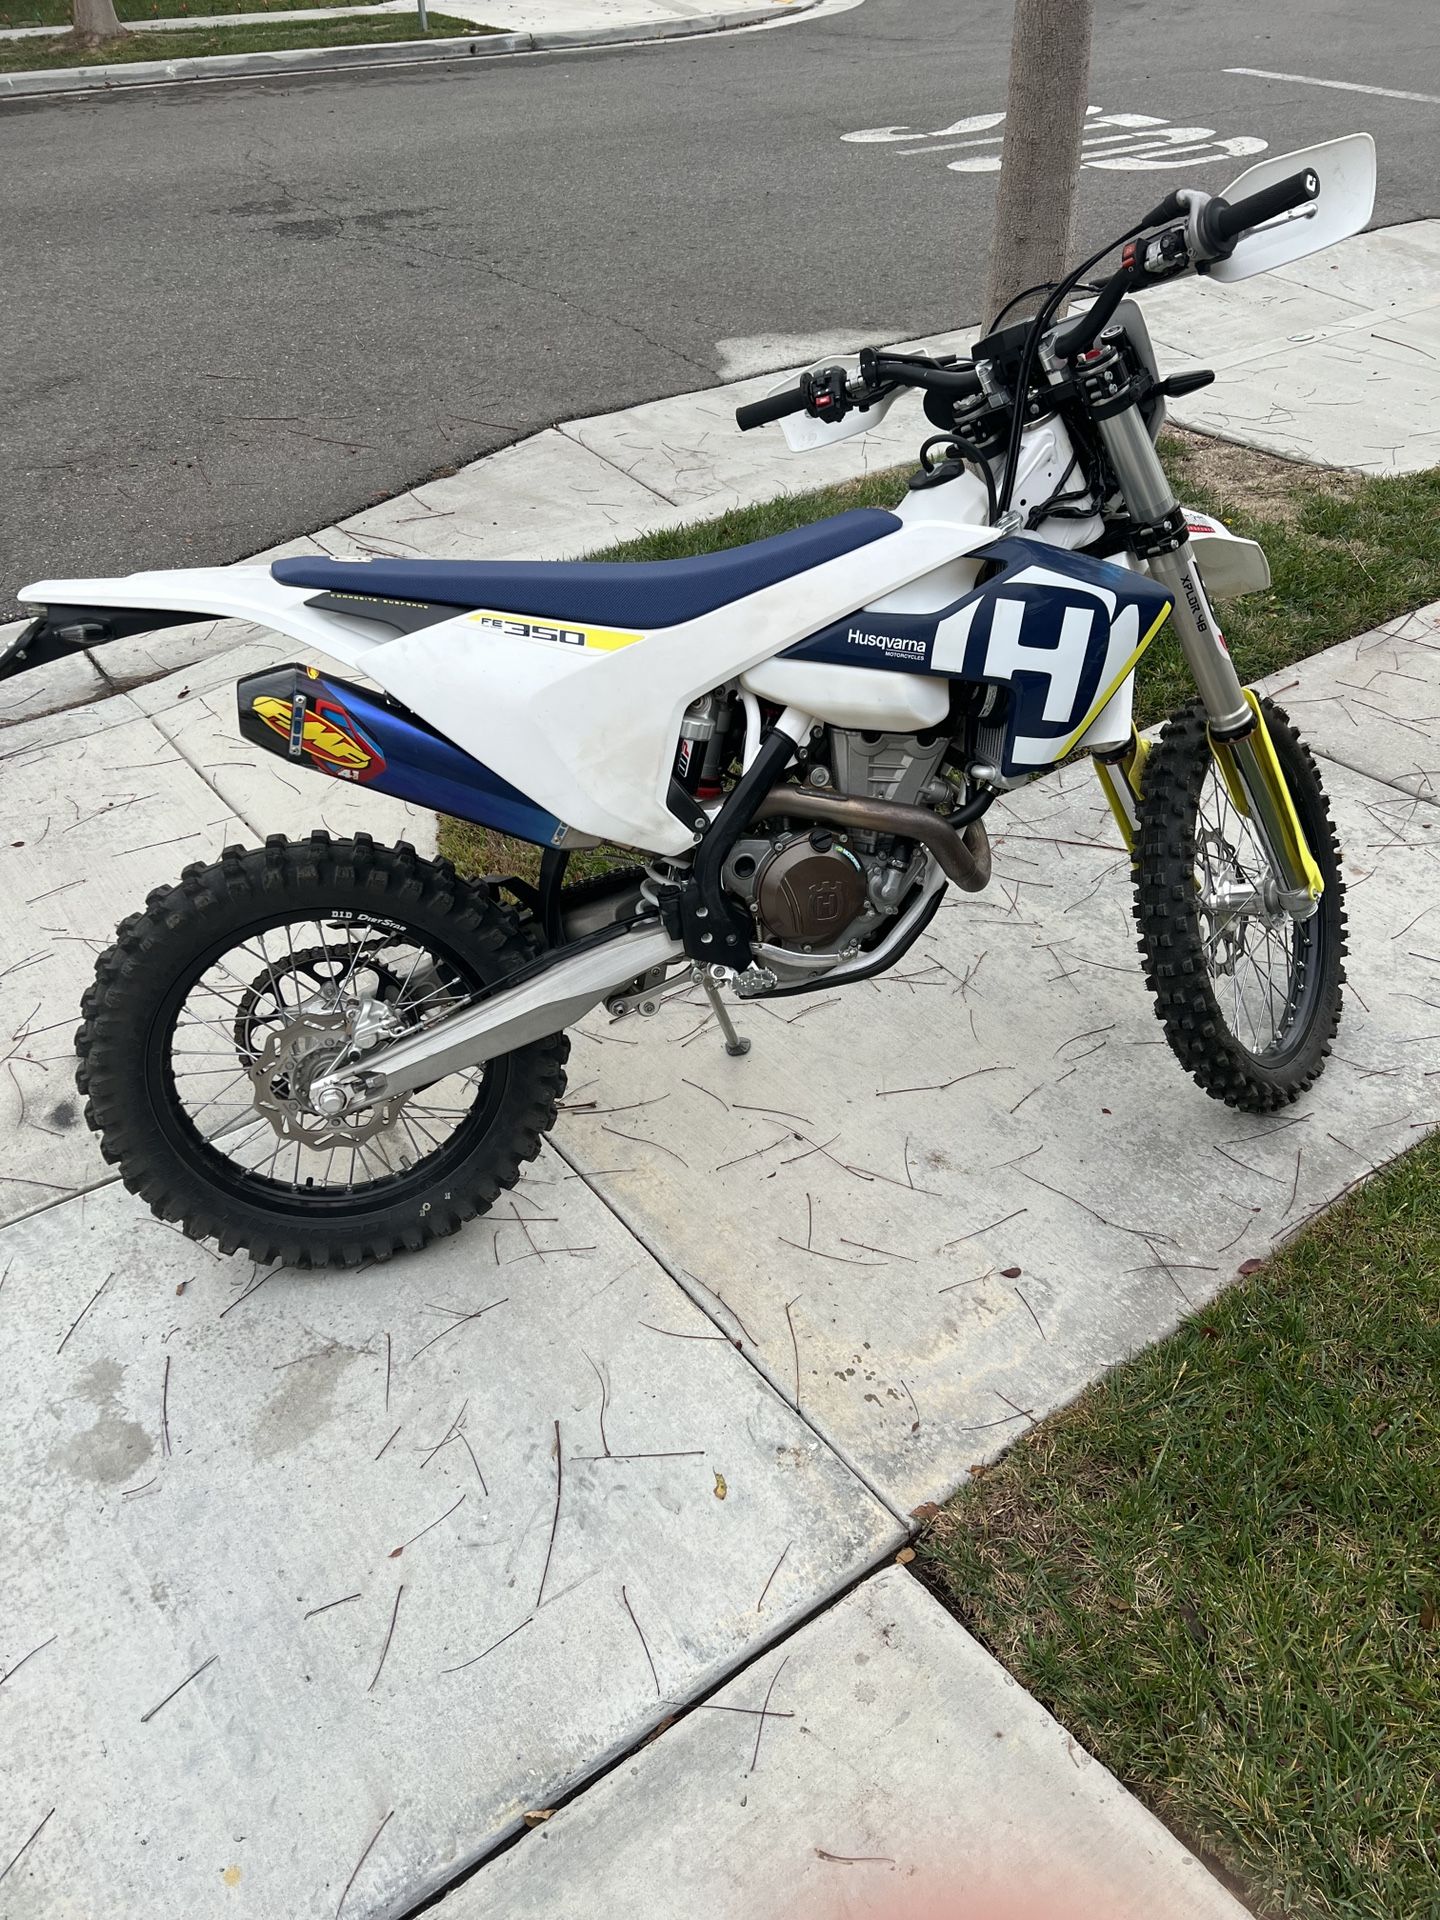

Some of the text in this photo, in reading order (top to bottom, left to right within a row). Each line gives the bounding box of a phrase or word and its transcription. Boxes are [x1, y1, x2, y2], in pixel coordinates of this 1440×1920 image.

[1180, 574, 1207, 633] XPLOR 48
[481, 617, 585, 646] FE 350
[848, 628, 927, 653] Husqvarna
[885, 650, 925, 661] MOTORCYCLES
